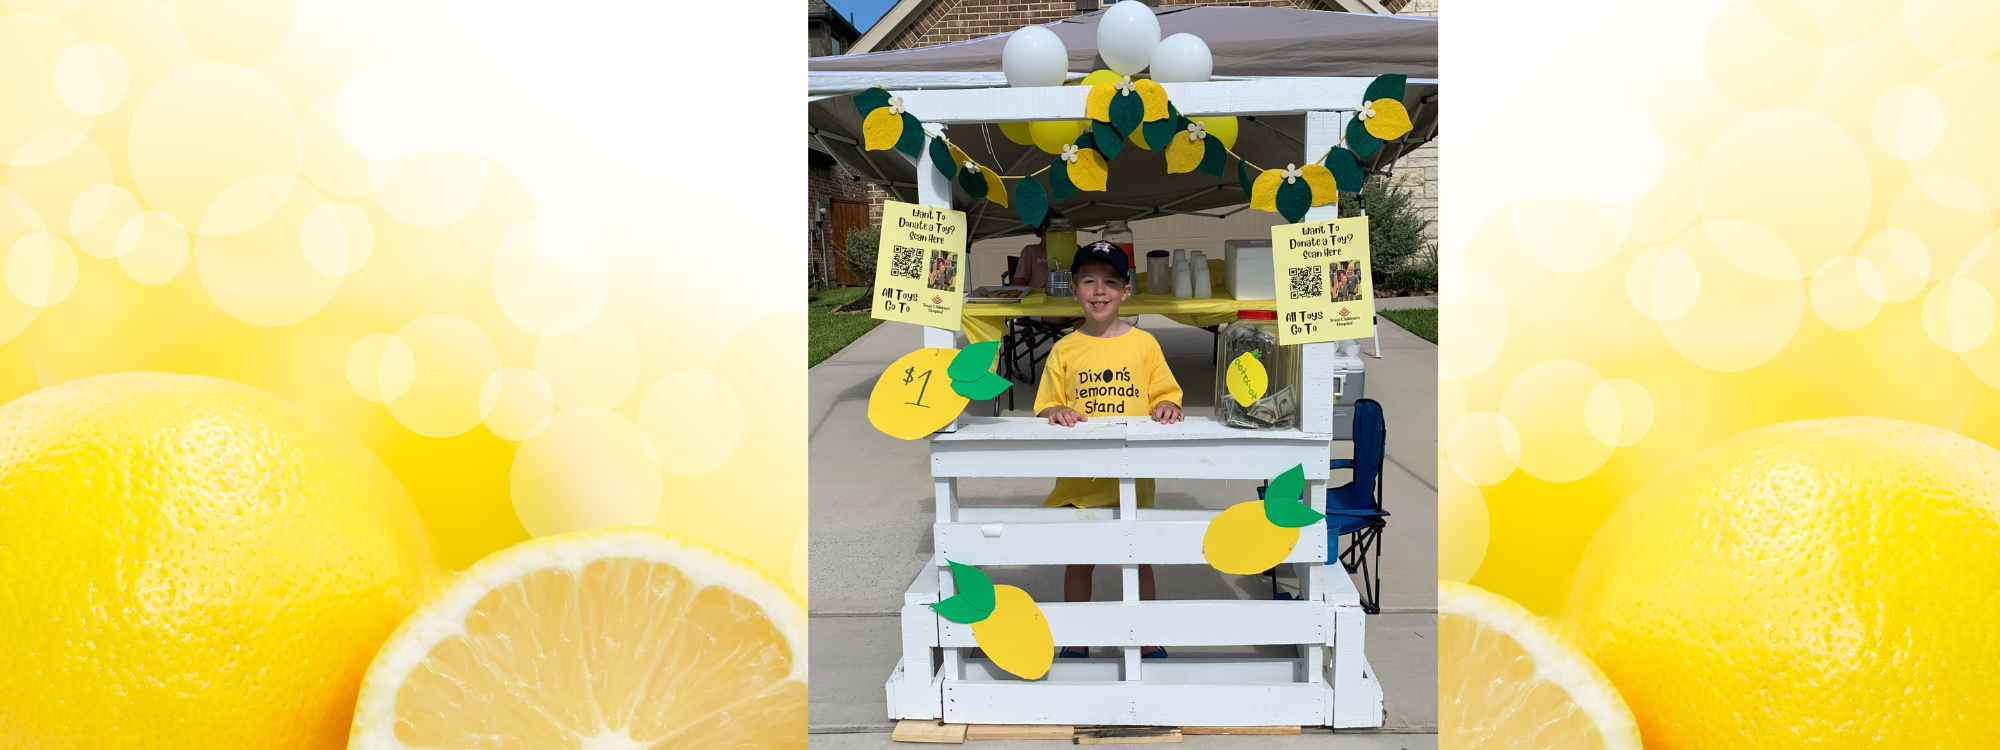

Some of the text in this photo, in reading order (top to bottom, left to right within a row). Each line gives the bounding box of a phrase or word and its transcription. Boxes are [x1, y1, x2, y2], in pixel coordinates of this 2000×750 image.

[912, 208, 945, 222] Want To
[898, 217, 928, 230] Donate
[936, 223, 955, 235] Toy?
[1302, 223, 1339, 235] Want To
[909, 231, 944, 244] Scan Here
[1289, 233, 1353, 250] Donate a Toy?
[1302, 247, 1342, 260] Scan Here
[882, 287, 918, 302] All Toys
[884, 300, 910, 313] Go To
[1285, 311, 1323, 322] All Toys
[1290, 323, 1317, 335] Go To
[903, 366, 932, 408] $1
[1085, 399, 1125, 414] Stand
